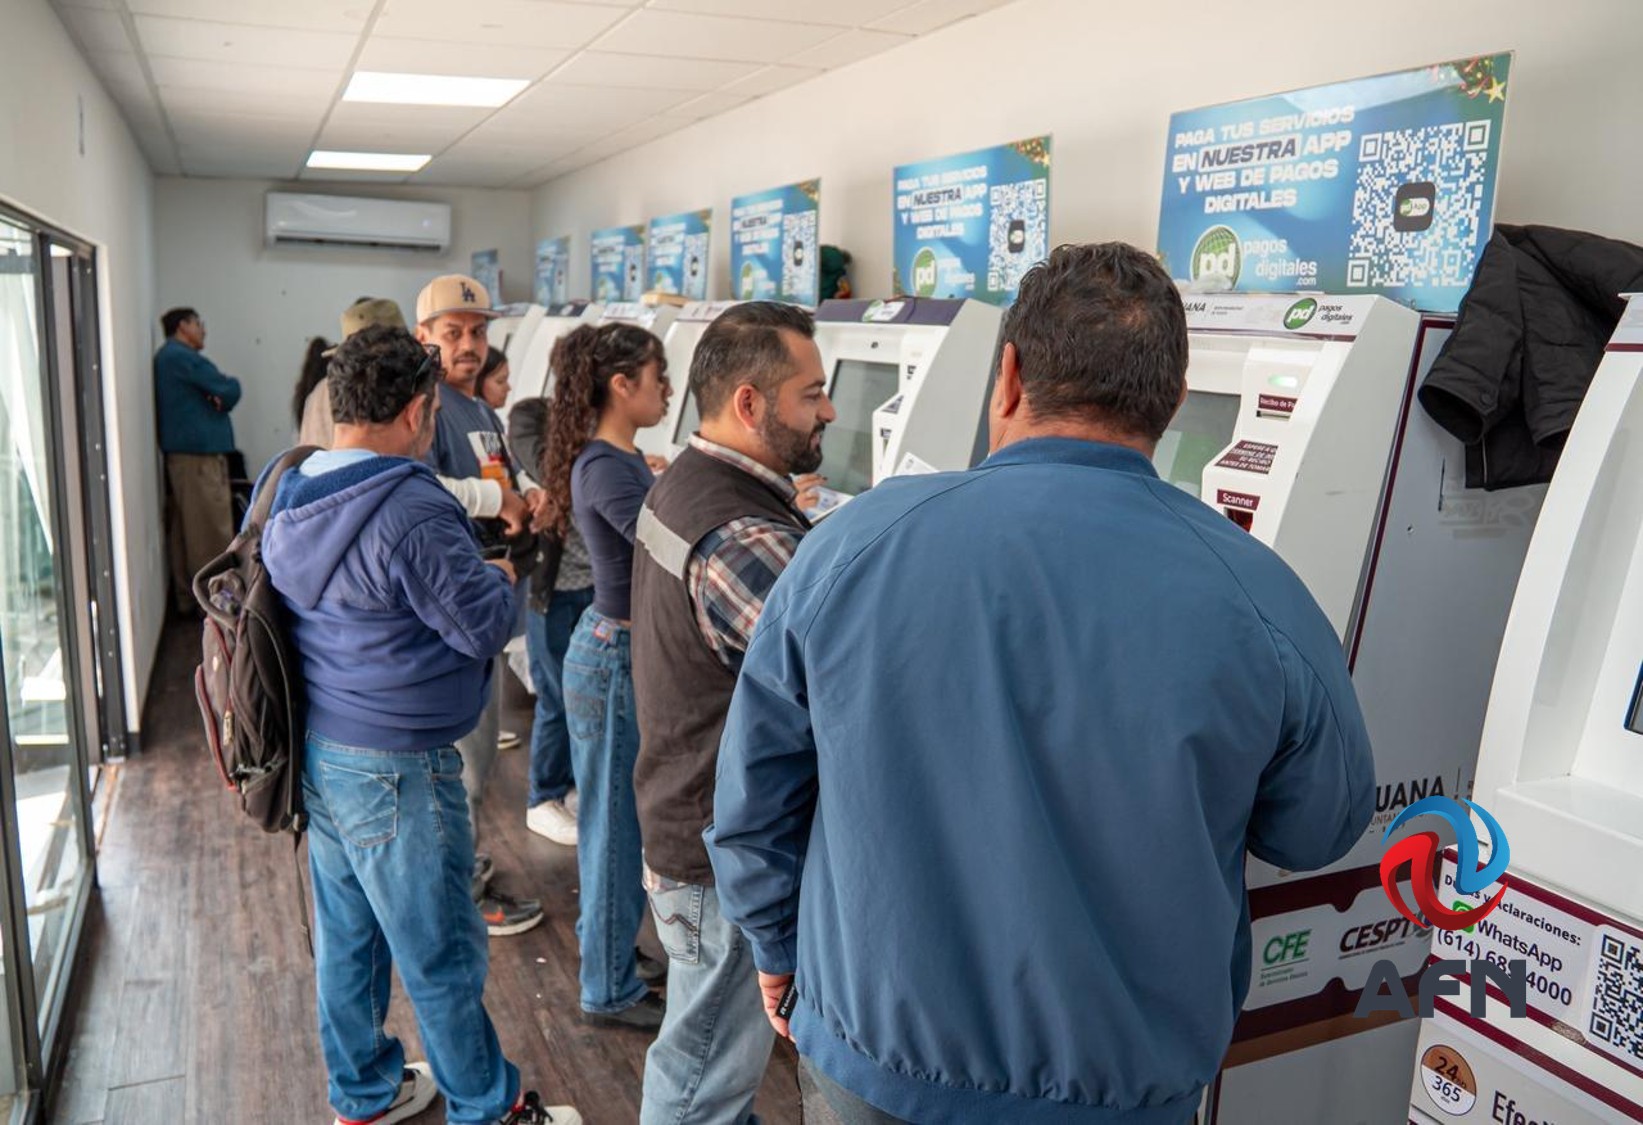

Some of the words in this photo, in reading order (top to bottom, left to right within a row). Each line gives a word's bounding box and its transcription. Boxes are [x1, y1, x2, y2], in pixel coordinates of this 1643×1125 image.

[1175, 128, 1215, 148] PAGA
[1221, 121, 1254, 141] TUS
[1259, 106, 1355, 135] SERVICIOS
[1172, 152, 1197, 172] EN
[1201, 138, 1297, 169] NUESTRA
[1302, 130, 1352, 155] APP
[1178, 175, 1191, 194] Y
[1195, 170, 1236, 192] WEB
[1240, 167, 1265, 187] DE
[1269, 158, 1339, 183] PAGOS
[913, 188, 962, 206] NUESTRA
[1204, 188, 1298, 214] DIGITALES
[1242, 239, 1288, 258] pagos
[1255, 258, 1318, 280] digitales
[460, 281, 475, 302] LA
[1287, 303, 1315, 323] pd
[1222, 492, 1254, 507] Scanner
[1263, 928, 1312, 966] CFE
[1438, 929, 1481, 961] (614)
[1478, 919, 1563, 972] WhatsApp
[1435, 1056, 1459, 1081] 24
[1432, 1075, 1462, 1102] 365
